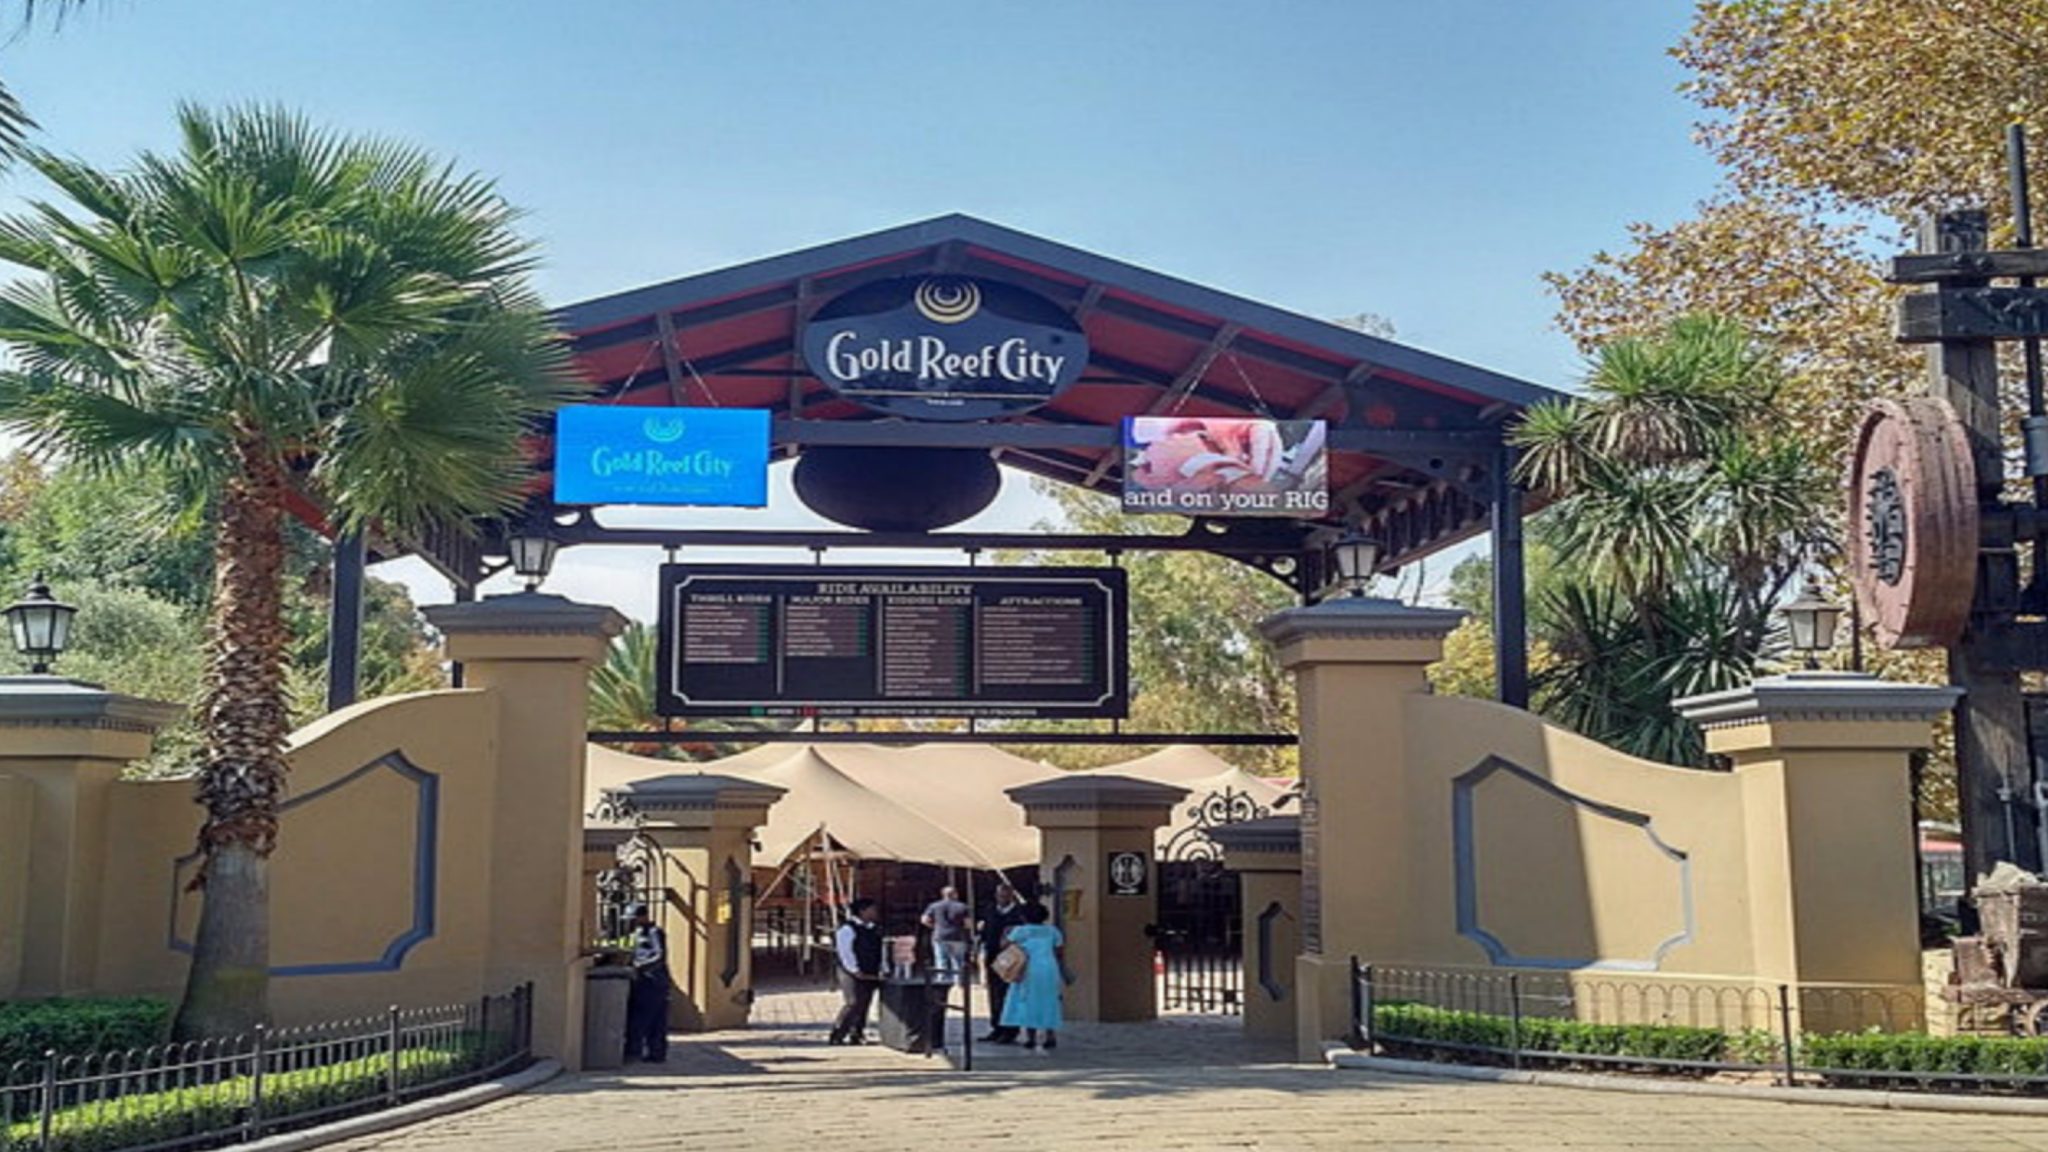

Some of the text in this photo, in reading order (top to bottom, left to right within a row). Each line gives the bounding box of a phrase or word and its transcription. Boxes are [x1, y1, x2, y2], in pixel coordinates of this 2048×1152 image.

[827, 331, 1064, 384] Gold Reef City
[592, 447, 732, 478] Gold Reef City
[1125, 489, 1329, 510] and on your RIG
[818, 584, 973, 595] RIDE AVAILABILITY
